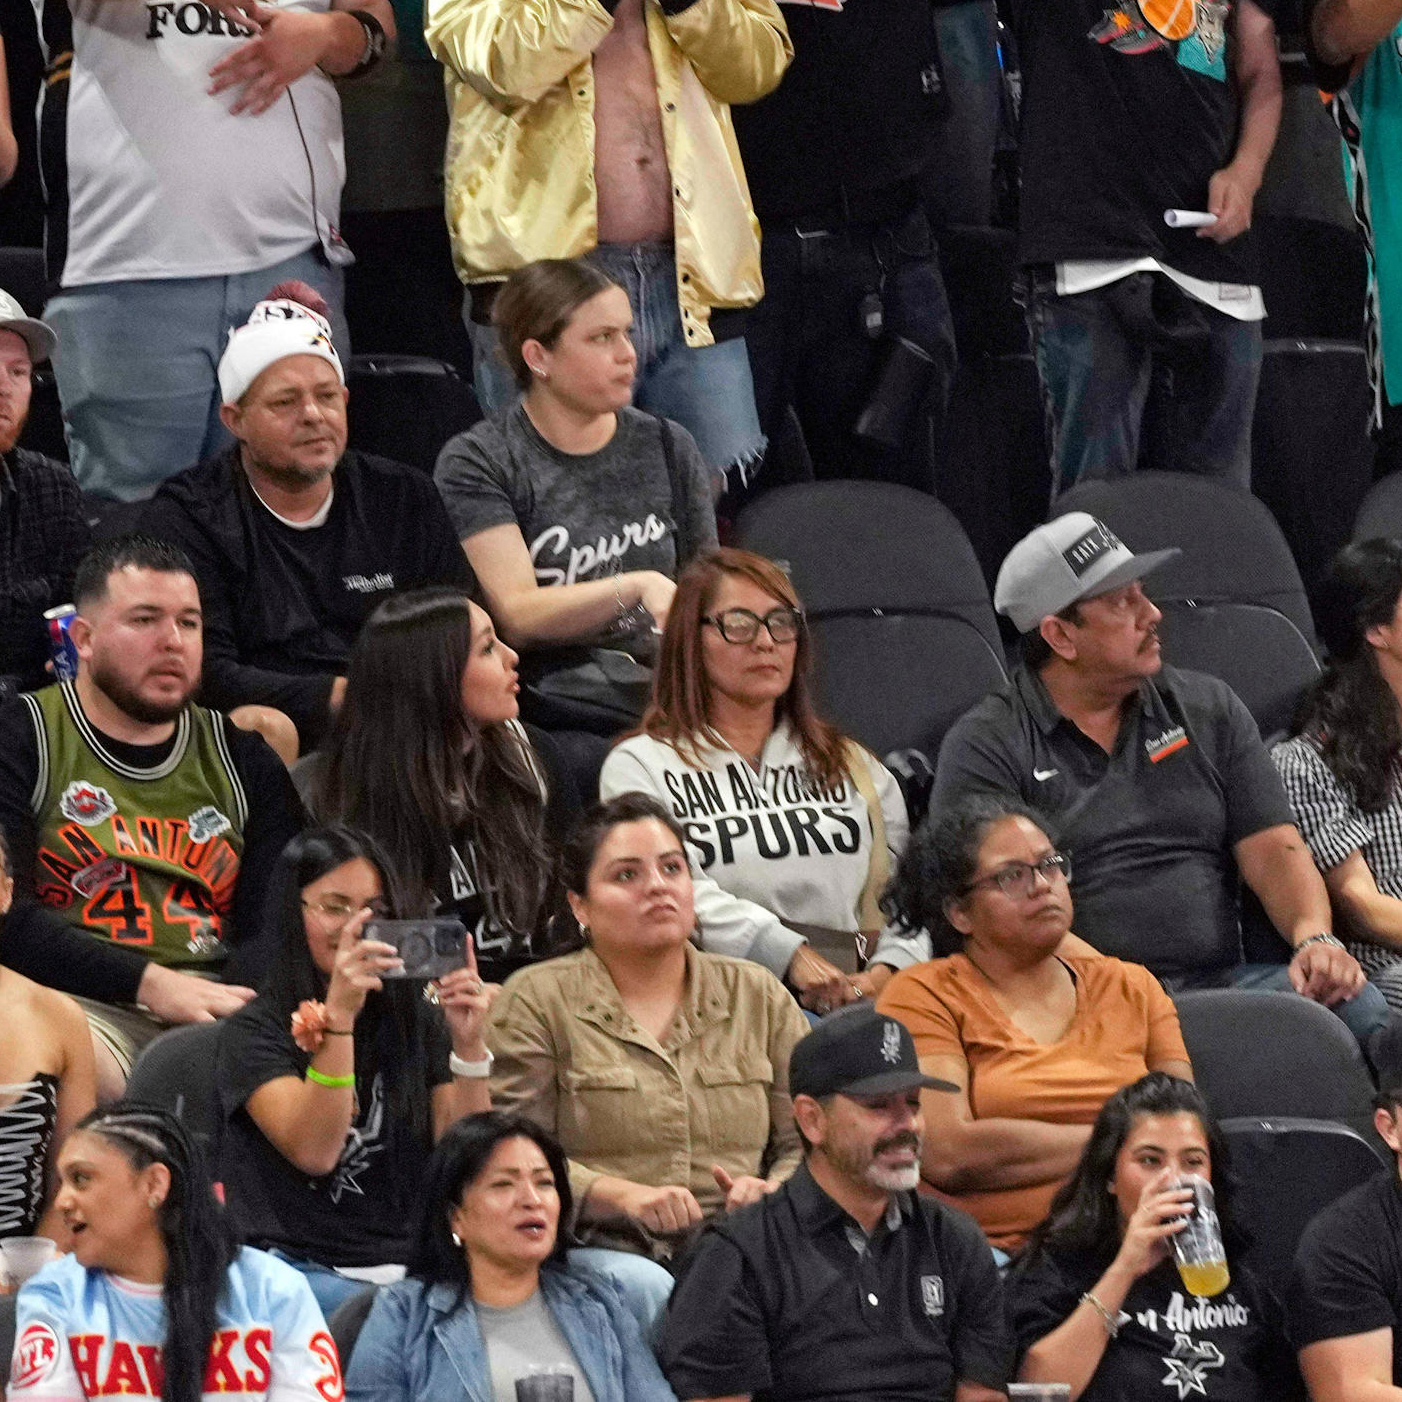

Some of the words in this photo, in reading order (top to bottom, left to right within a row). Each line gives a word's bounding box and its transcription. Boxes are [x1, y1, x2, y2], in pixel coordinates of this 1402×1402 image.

[530, 511, 666, 589] Spurs
[663, 766, 736, 820] SAN
[682, 802, 862, 872] SPURS
[82, 864, 222, 946] 44
[1165, 1290, 1252, 1334] Antonio
